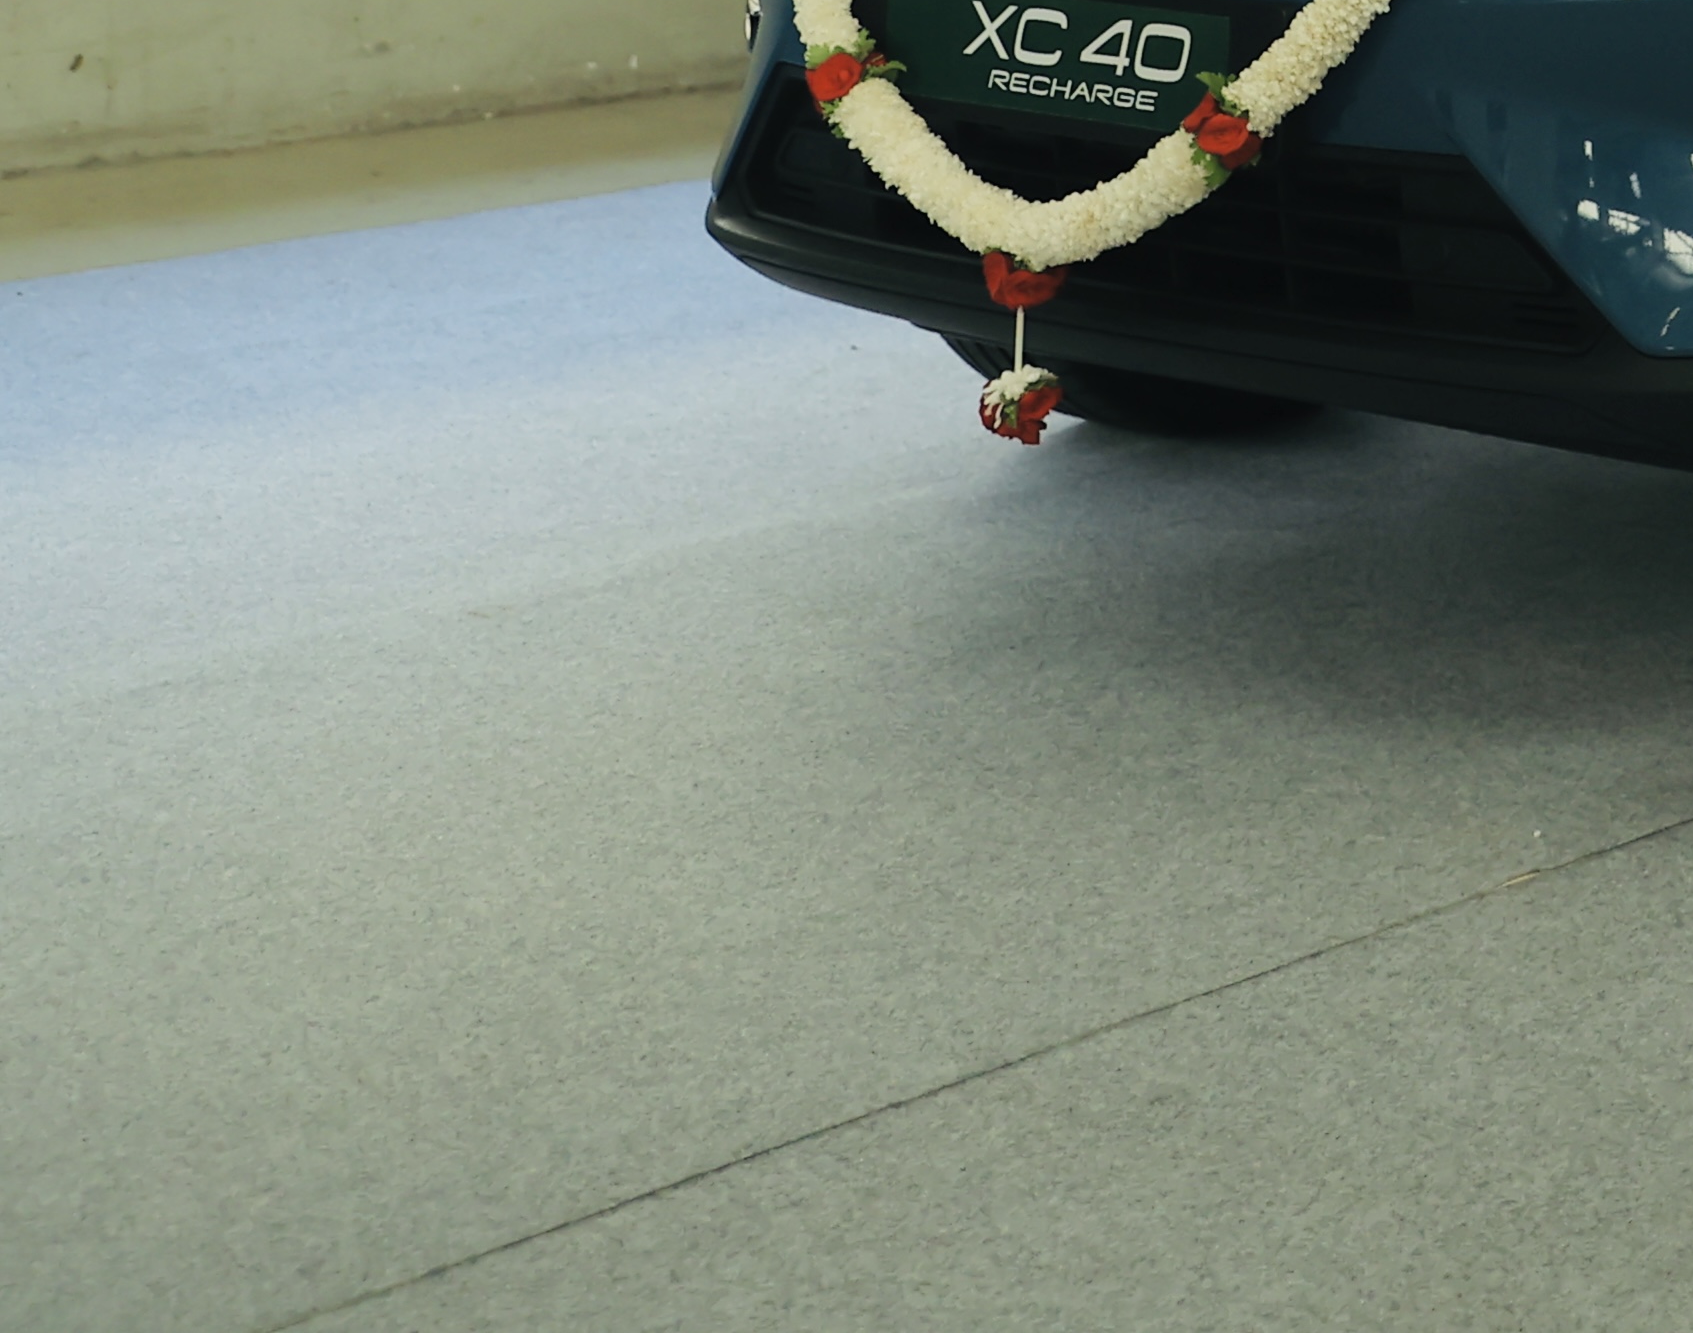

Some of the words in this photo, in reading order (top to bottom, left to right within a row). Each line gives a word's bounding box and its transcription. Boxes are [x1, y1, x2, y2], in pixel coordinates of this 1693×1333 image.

[962, 0, 1068, 66] XC
[1079, 19, 1192, 83] 40
[987, 69, 1160, 112] RECHARGE
